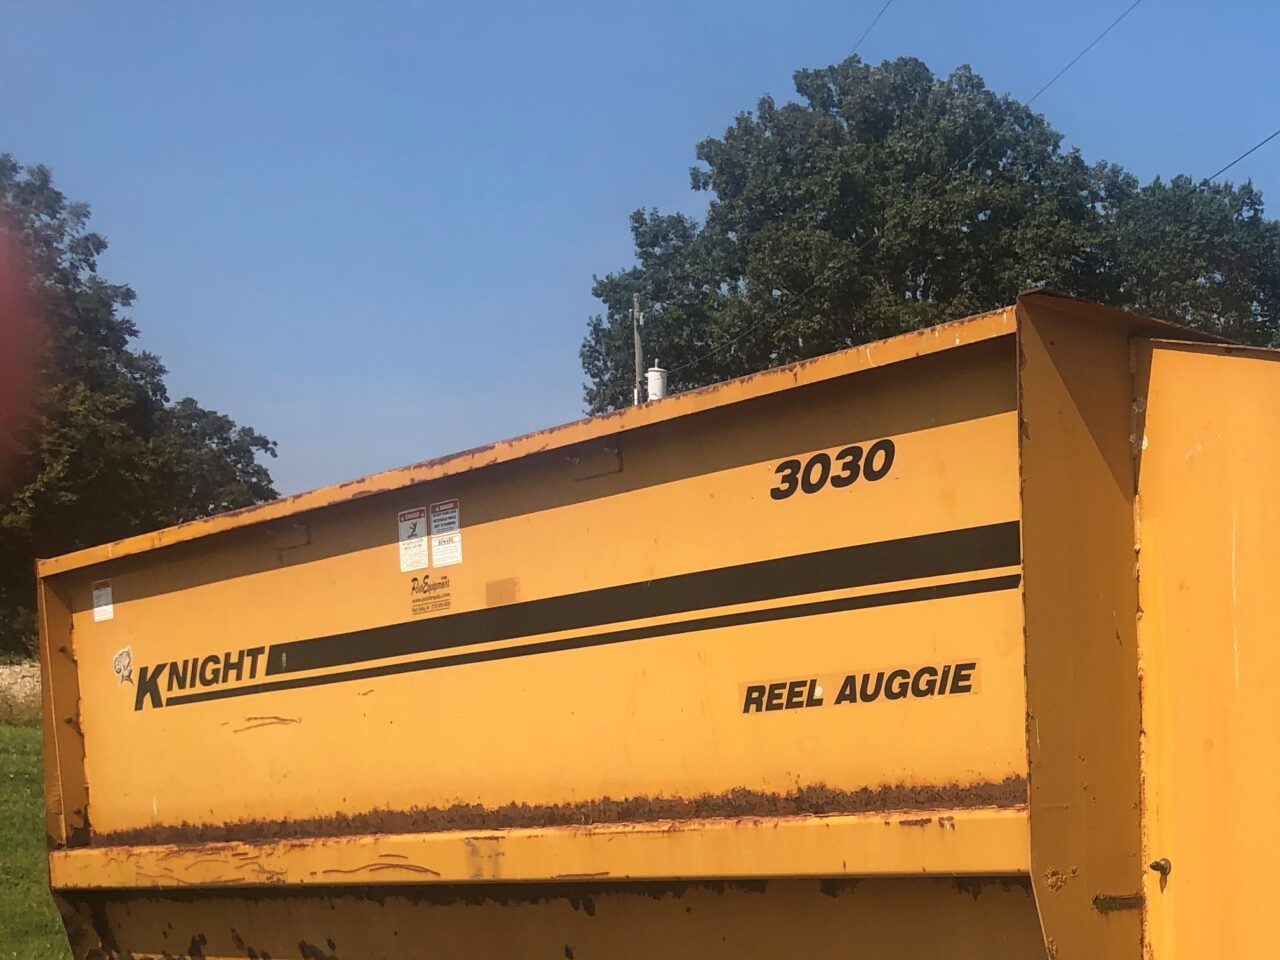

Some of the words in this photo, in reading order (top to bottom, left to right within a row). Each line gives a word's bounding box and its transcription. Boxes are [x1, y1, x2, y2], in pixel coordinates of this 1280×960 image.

[770, 439, 895, 500] 3030
[134, 646, 265, 711] KNIGHT
[743, 679, 824, 713] REEL
[834, 663, 977, 704] AUGGIE
